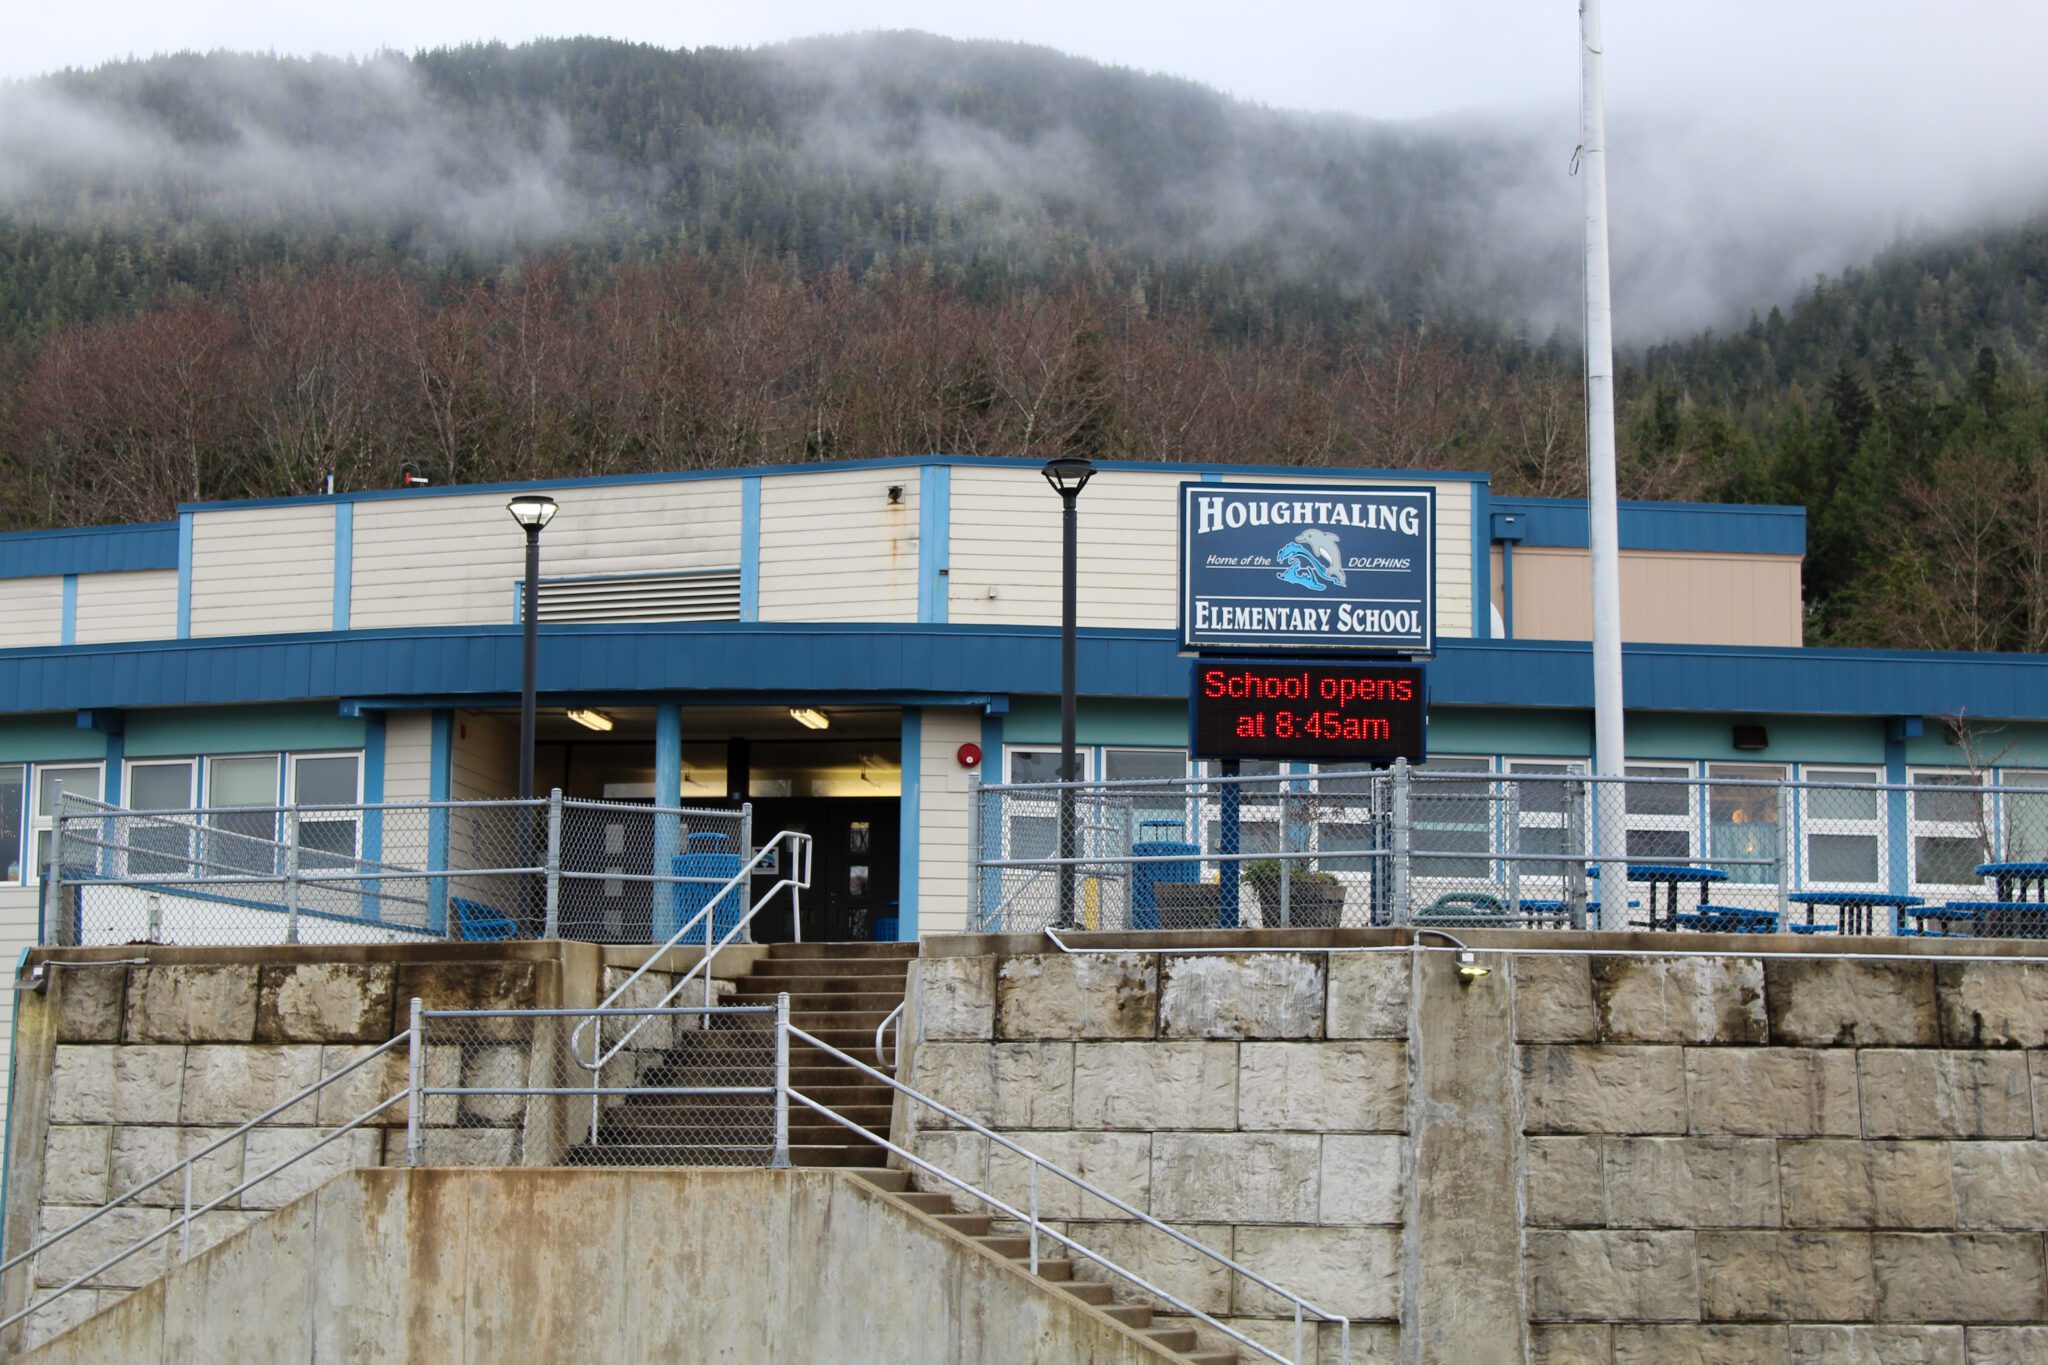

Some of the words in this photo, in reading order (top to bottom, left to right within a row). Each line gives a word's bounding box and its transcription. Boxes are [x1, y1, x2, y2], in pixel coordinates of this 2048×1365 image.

[1198, 497, 1419, 536] HOUGHTALING
[1206, 555, 1238, 565] Home
[1240, 555, 1254, 565] of
[1253, 555, 1271, 566] the
[1348, 557, 1410, 568] DOLPHINS
[1195, 601, 1331, 631] ELEMENTARY
[1337, 603, 1421, 633] SCHOOL
[1205, 671, 1308, 698] School
[1320, 679, 1413, 708] opens
[1236, 712, 1266, 737] at
[1275, 711, 1390, 739] 8:45am
